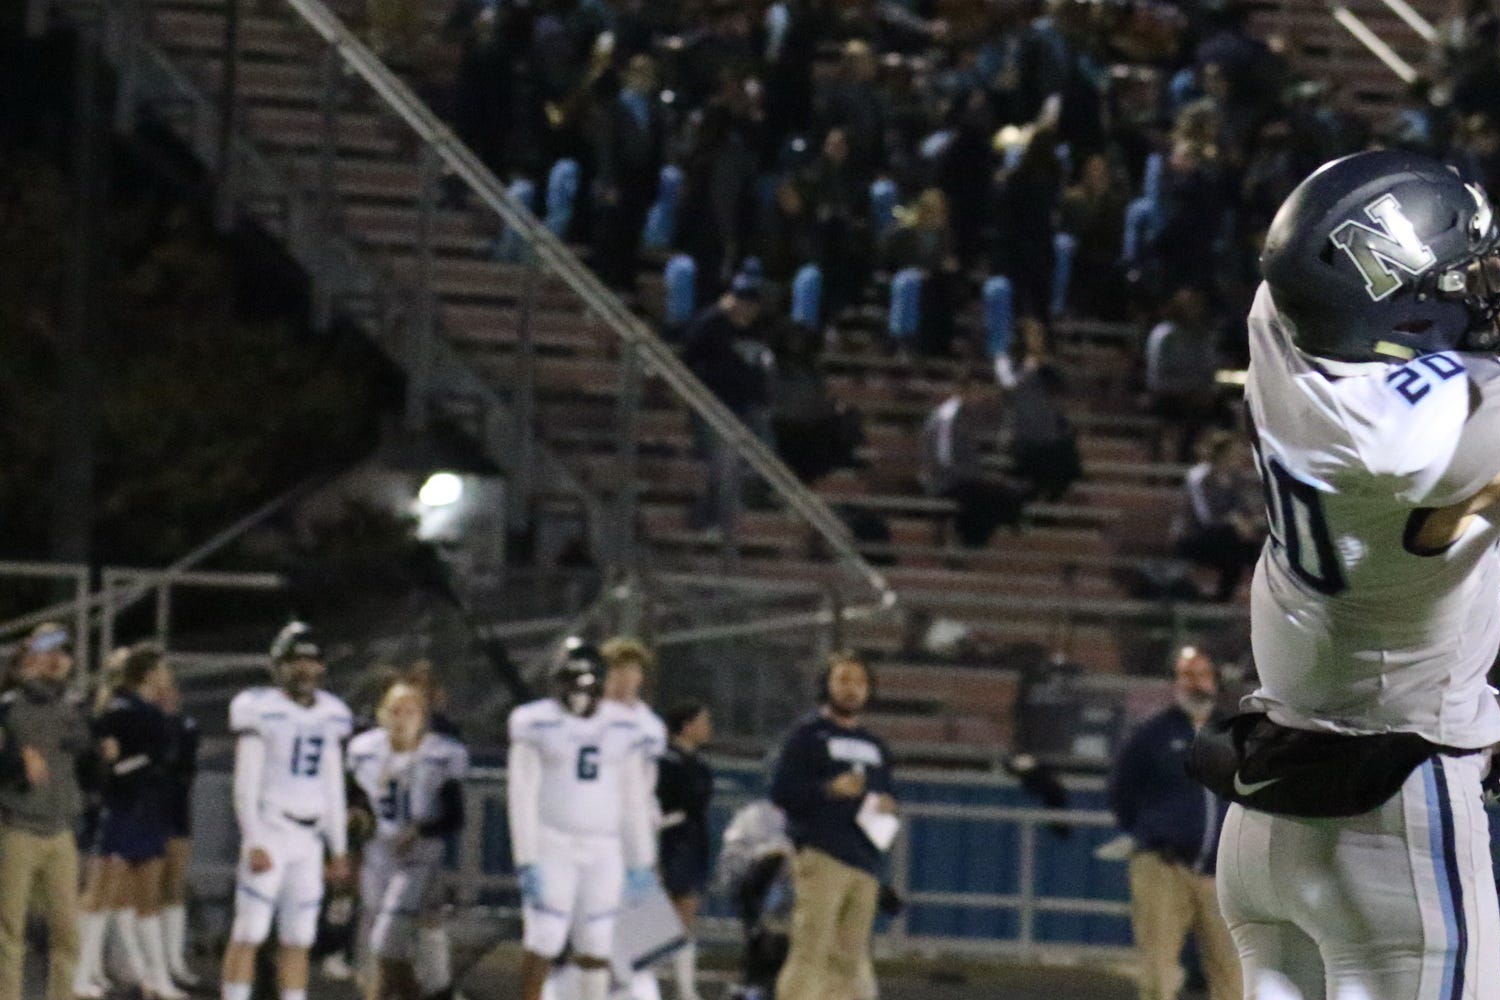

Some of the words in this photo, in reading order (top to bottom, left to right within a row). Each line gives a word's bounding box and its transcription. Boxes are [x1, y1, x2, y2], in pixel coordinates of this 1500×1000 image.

[1328, 192, 1438, 302] N
[1386, 352, 1467, 406] 20
[291, 736, 324, 777] 13
